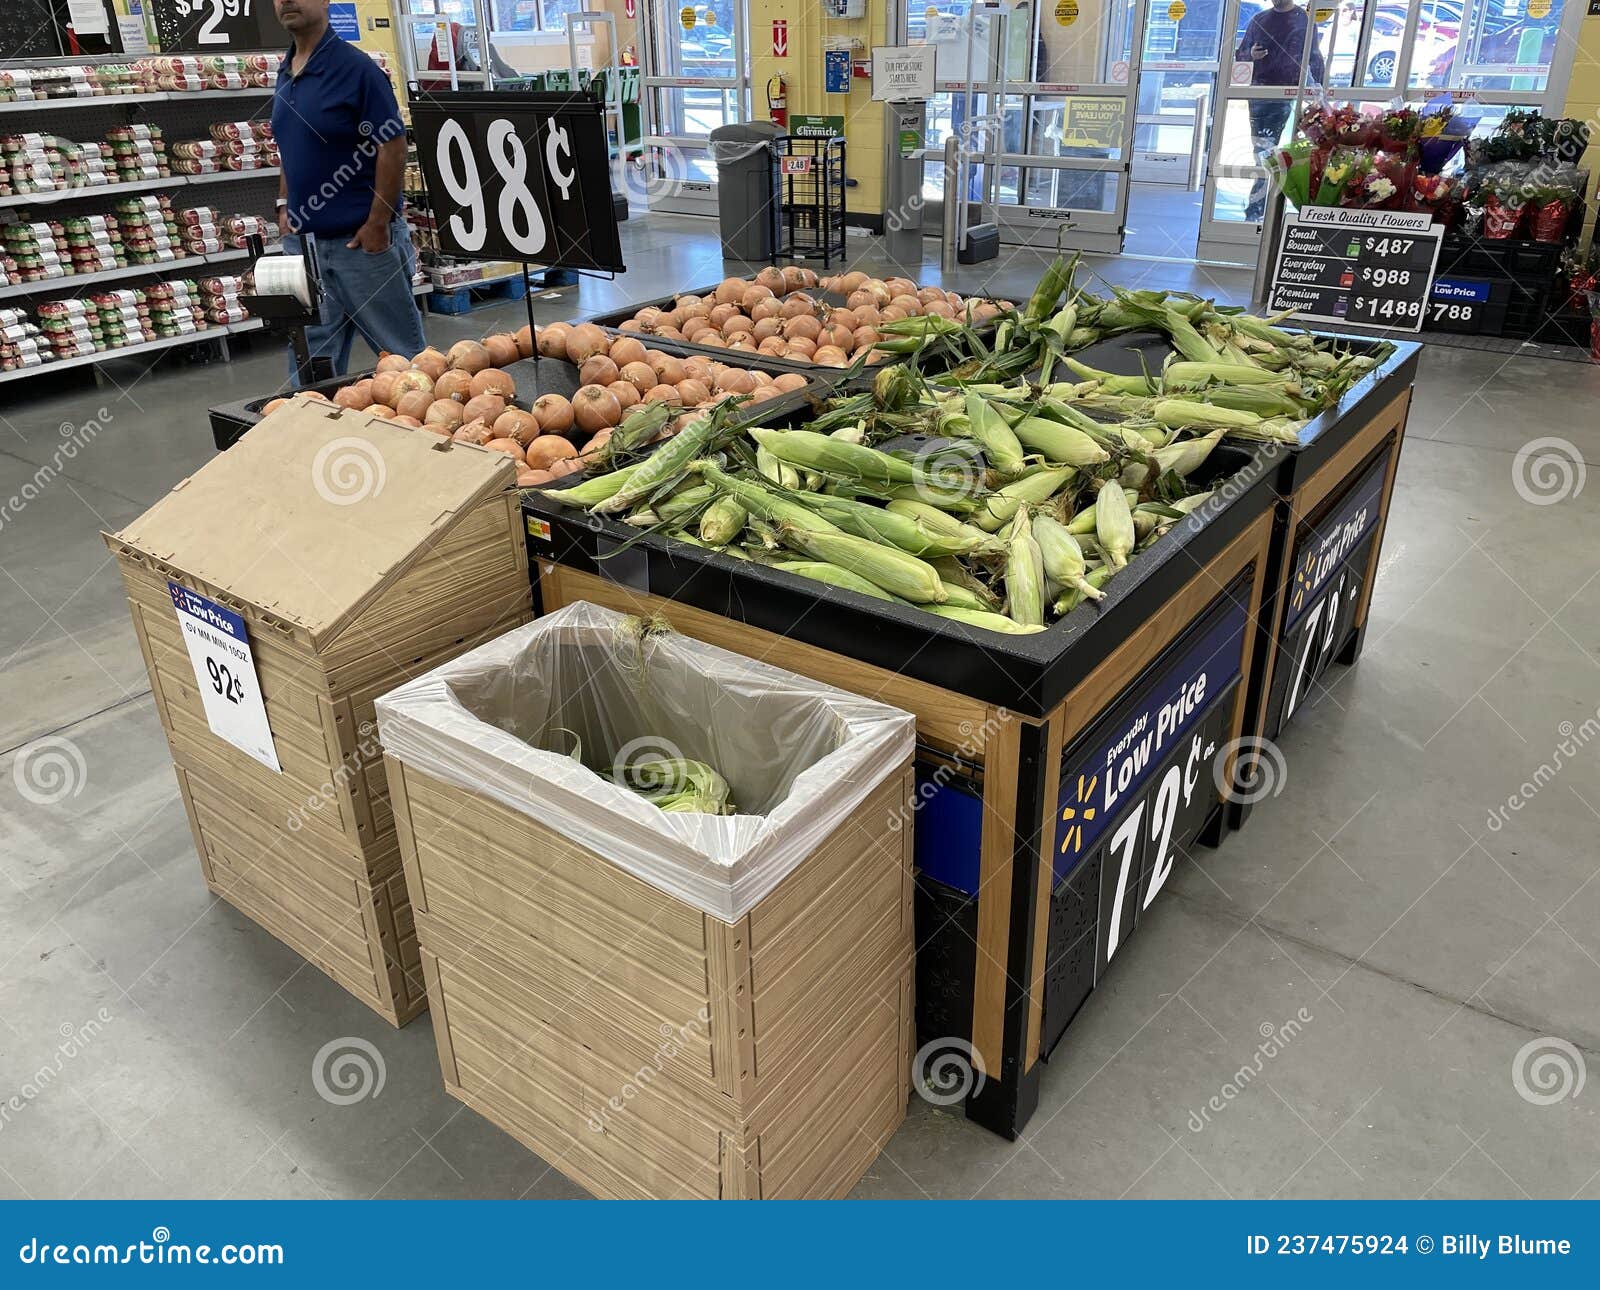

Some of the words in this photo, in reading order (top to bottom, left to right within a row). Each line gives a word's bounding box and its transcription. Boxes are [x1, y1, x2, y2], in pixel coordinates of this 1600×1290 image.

[796, 125, 838, 137] Chronicle
[437, 117, 575, 255] 98¢
[1305, 208, 1335, 223] Fresh
[1338, 211, 1378, 227] Quality
[1381, 214, 1424, 228] Flowers
[1288, 228, 1318, 240] Small
[1286, 240, 1324, 253] Bouquet
[1365, 236, 1414, 257] $487
[1282, 257, 1326, 271] Everyday
[1280, 269, 1317, 282] Bouquet
[1362, 267, 1410, 288] $988
[1276, 286, 1320, 300] Premium
[1434, 285, 1453, 295] Low
[1453, 287, 1476, 297] Price
[1274, 298, 1313, 311] Bouquet
[1355, 296, 1420, 318] $1488
[1313, 539, 1341, 590] Low
[1339, 508, 1367, 558] Price
[185, 597, 208, 620] Low
[207, 608, 234, 634] Price
[211, 635, 228, 651] MINI
[206, 656, 245, 705] 92¢
[1104, 729, 1154, 813] Low
[1155, 672, 1207, 751] Price
[1106, 711, 1149, 767] Everyday
